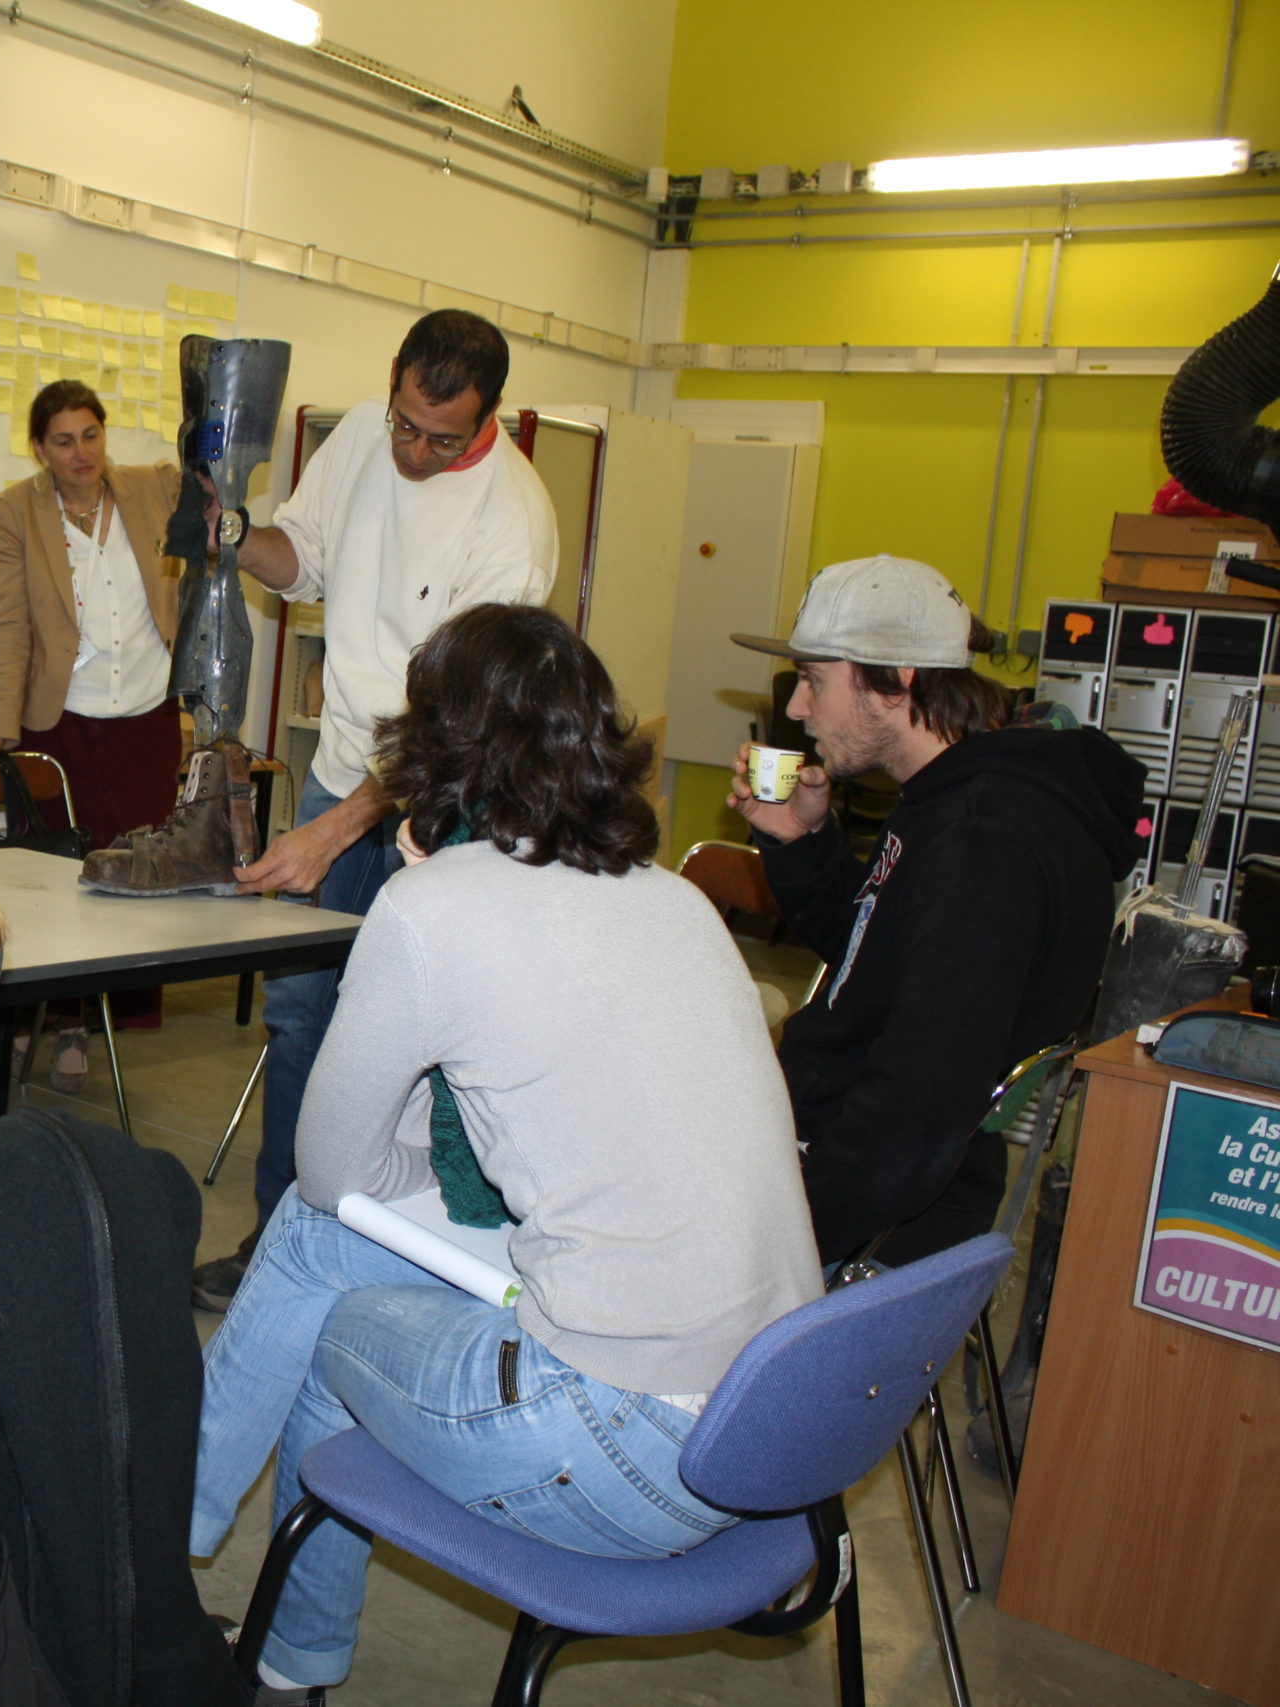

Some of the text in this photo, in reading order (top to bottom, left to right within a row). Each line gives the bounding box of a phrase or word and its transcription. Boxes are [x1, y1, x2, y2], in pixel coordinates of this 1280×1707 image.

[1247, 1115, 1280, 1140] As
[1218, 1134, 1243, 1158] la
[1228, 1167, 1255, 1188] et
[1209, 1191, 1267, 1215] rendre
